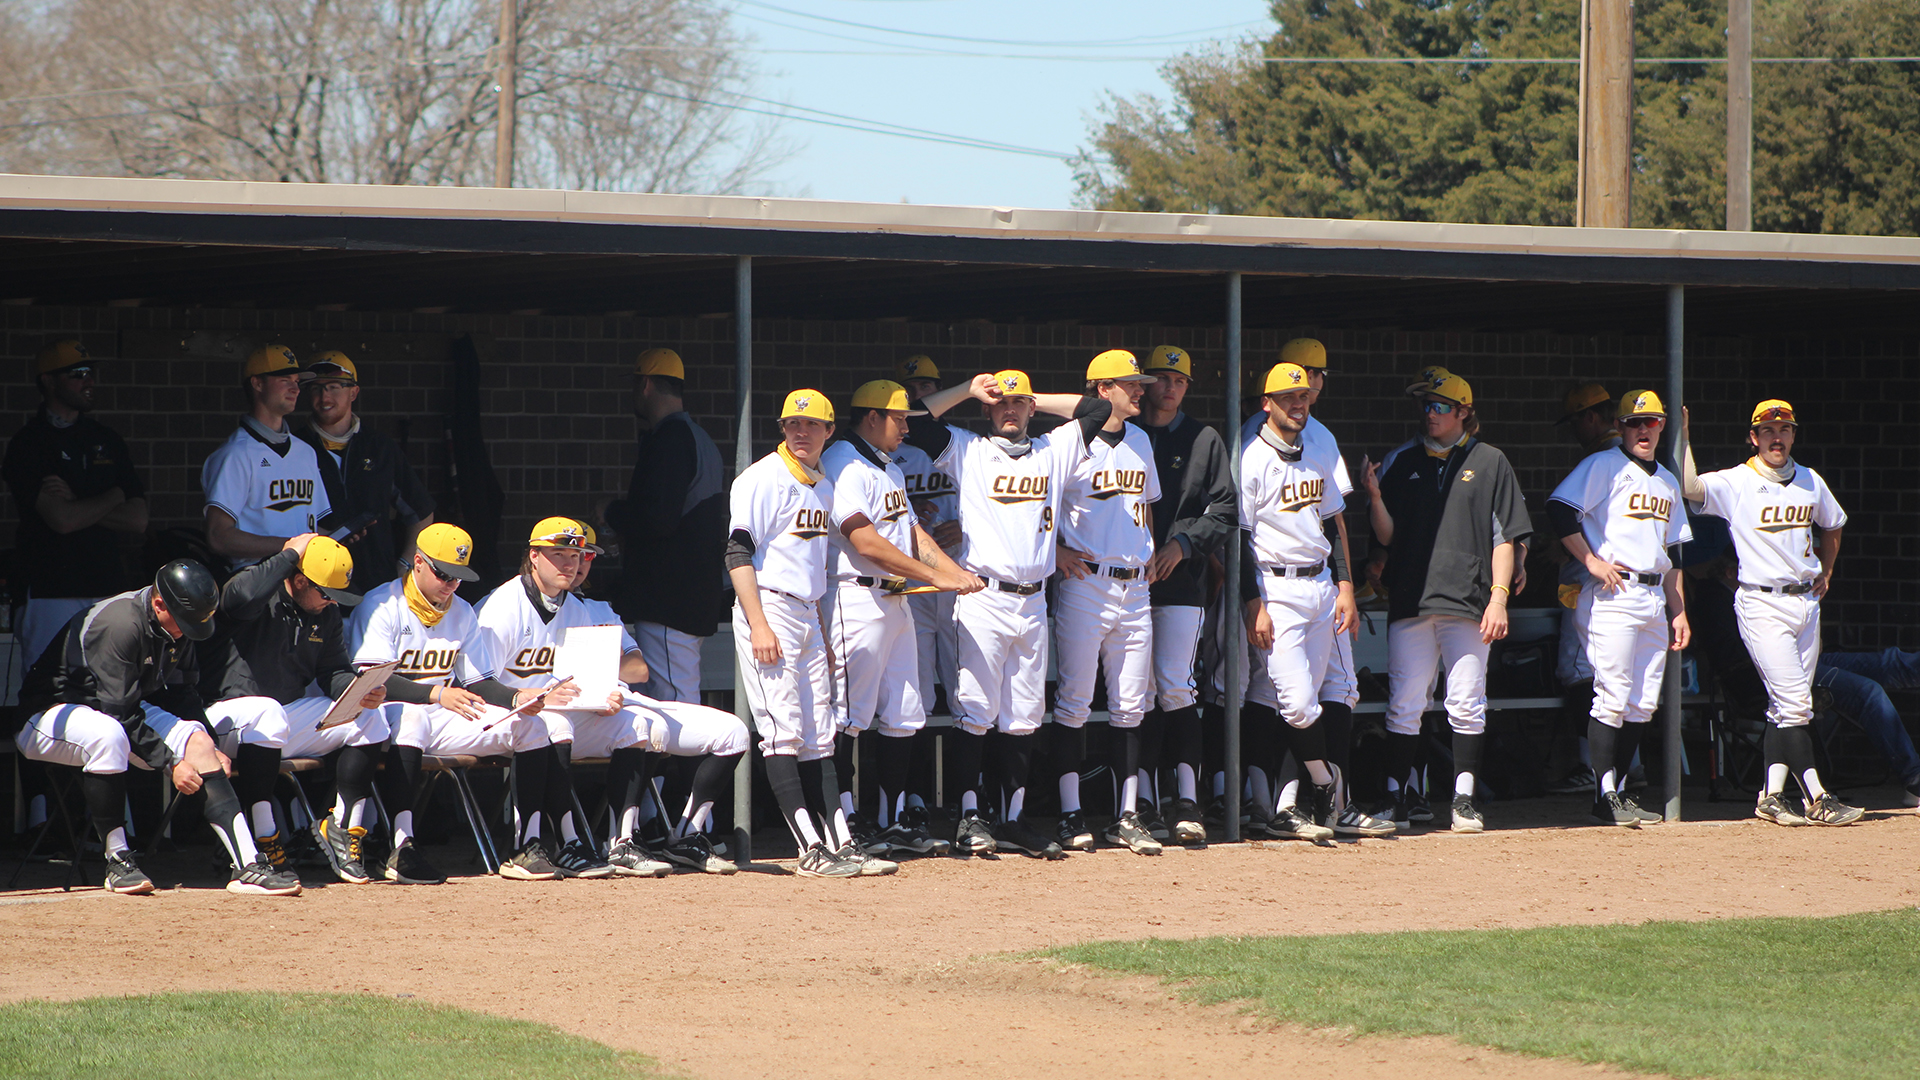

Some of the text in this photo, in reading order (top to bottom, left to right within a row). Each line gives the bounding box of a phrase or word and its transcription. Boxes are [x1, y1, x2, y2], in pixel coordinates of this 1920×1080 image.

[268, 478, 315, 501] CLOUD
[1091, 468, 1147, 491] CLOUD
[1132, 501, 1147, 529] 31
[514, 646, 555, 668] CLO
